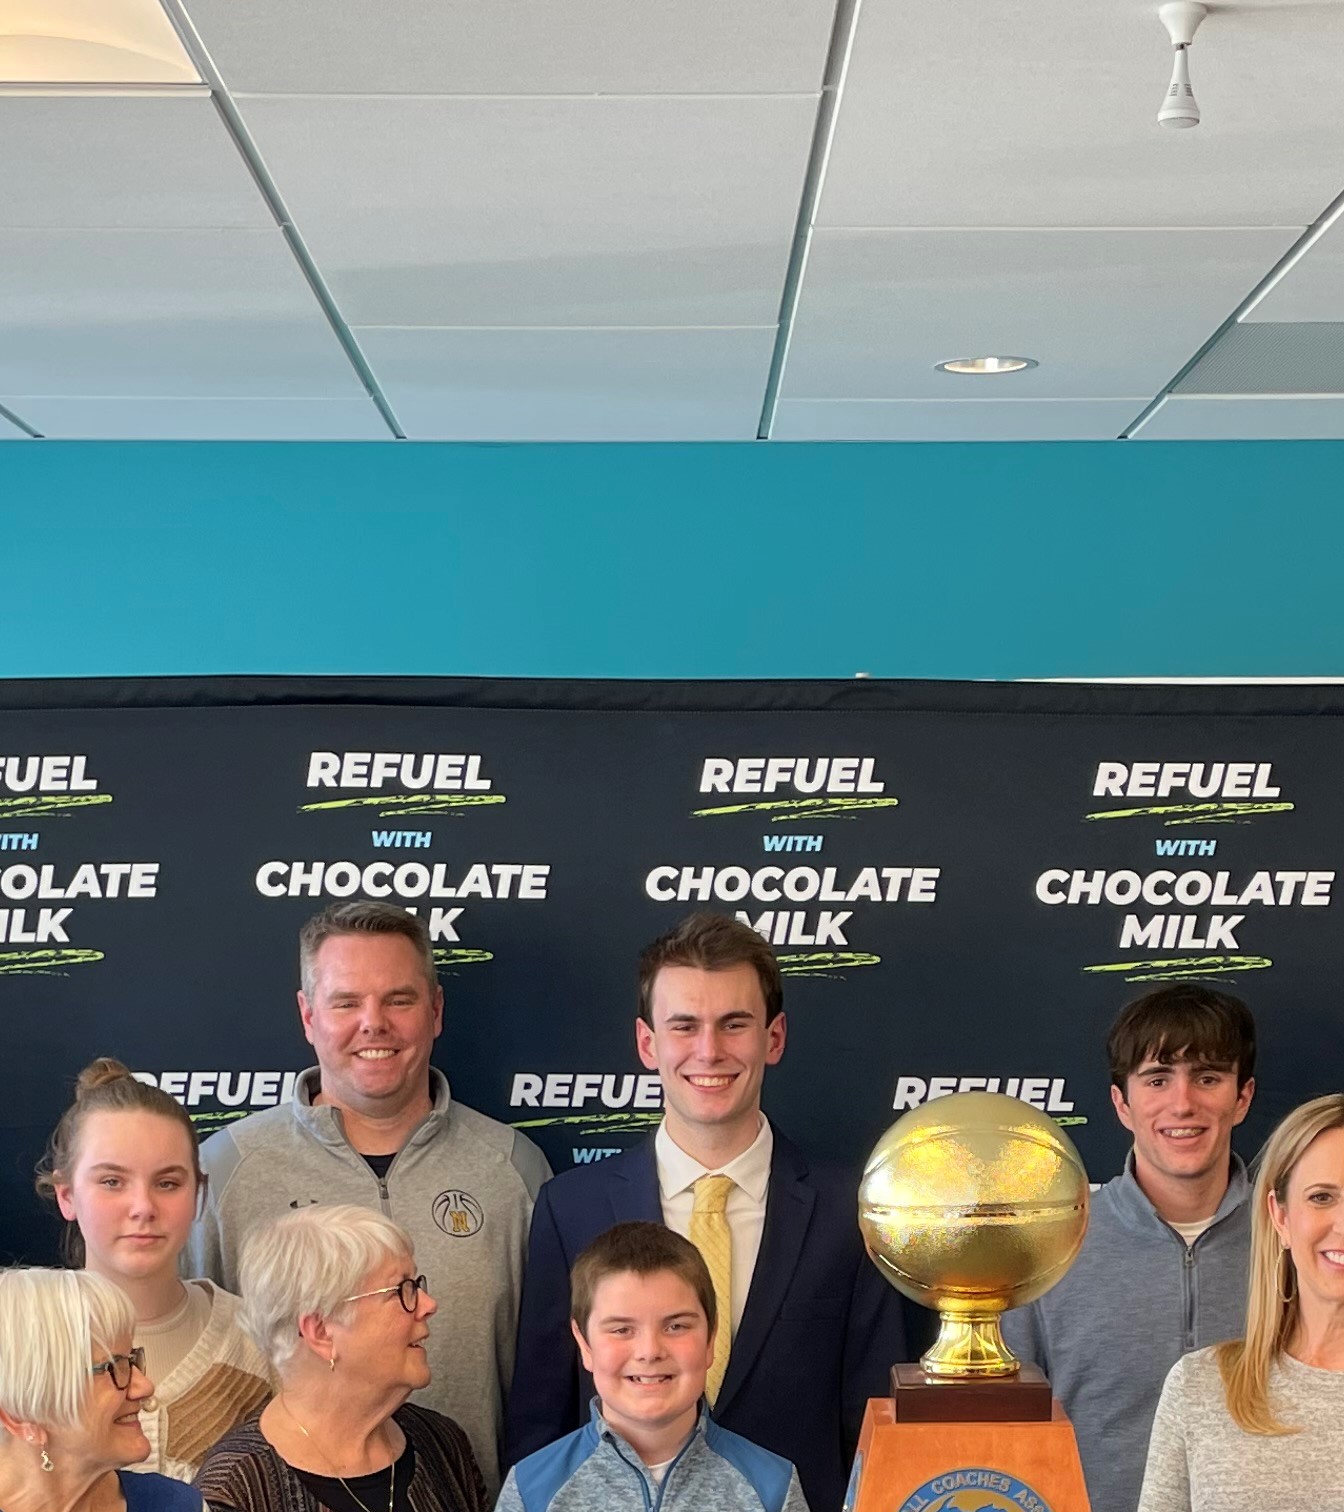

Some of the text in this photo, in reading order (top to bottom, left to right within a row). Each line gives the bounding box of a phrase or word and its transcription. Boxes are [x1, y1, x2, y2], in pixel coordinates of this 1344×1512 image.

[307, 752, 491, 789] REFUEL
[700, 758, 885, 793] REFUEL
[1093, 763, 1280, 797] REFUEL
[372, 831, 431, 848] WITH
[763, 836, 823, 851] WITH
[1156, 840, 1216, 856] WITH
[256, 862, 550, 898] CHOCOLATE
[646, 866, 940, 902] CHOCOLATE
[1036, 870, 1335, 905] CHOCOLATE
[735, 910, 853, 945] MILK
[1119, 915, 1244, 948] MILK
[510, 1073, 667, 1108] REFUE
[572, 1148, 622, 1164] WIT
[450, 1211, 470, 1232] N
[931, 1471, 1012, 1495] COACHES
